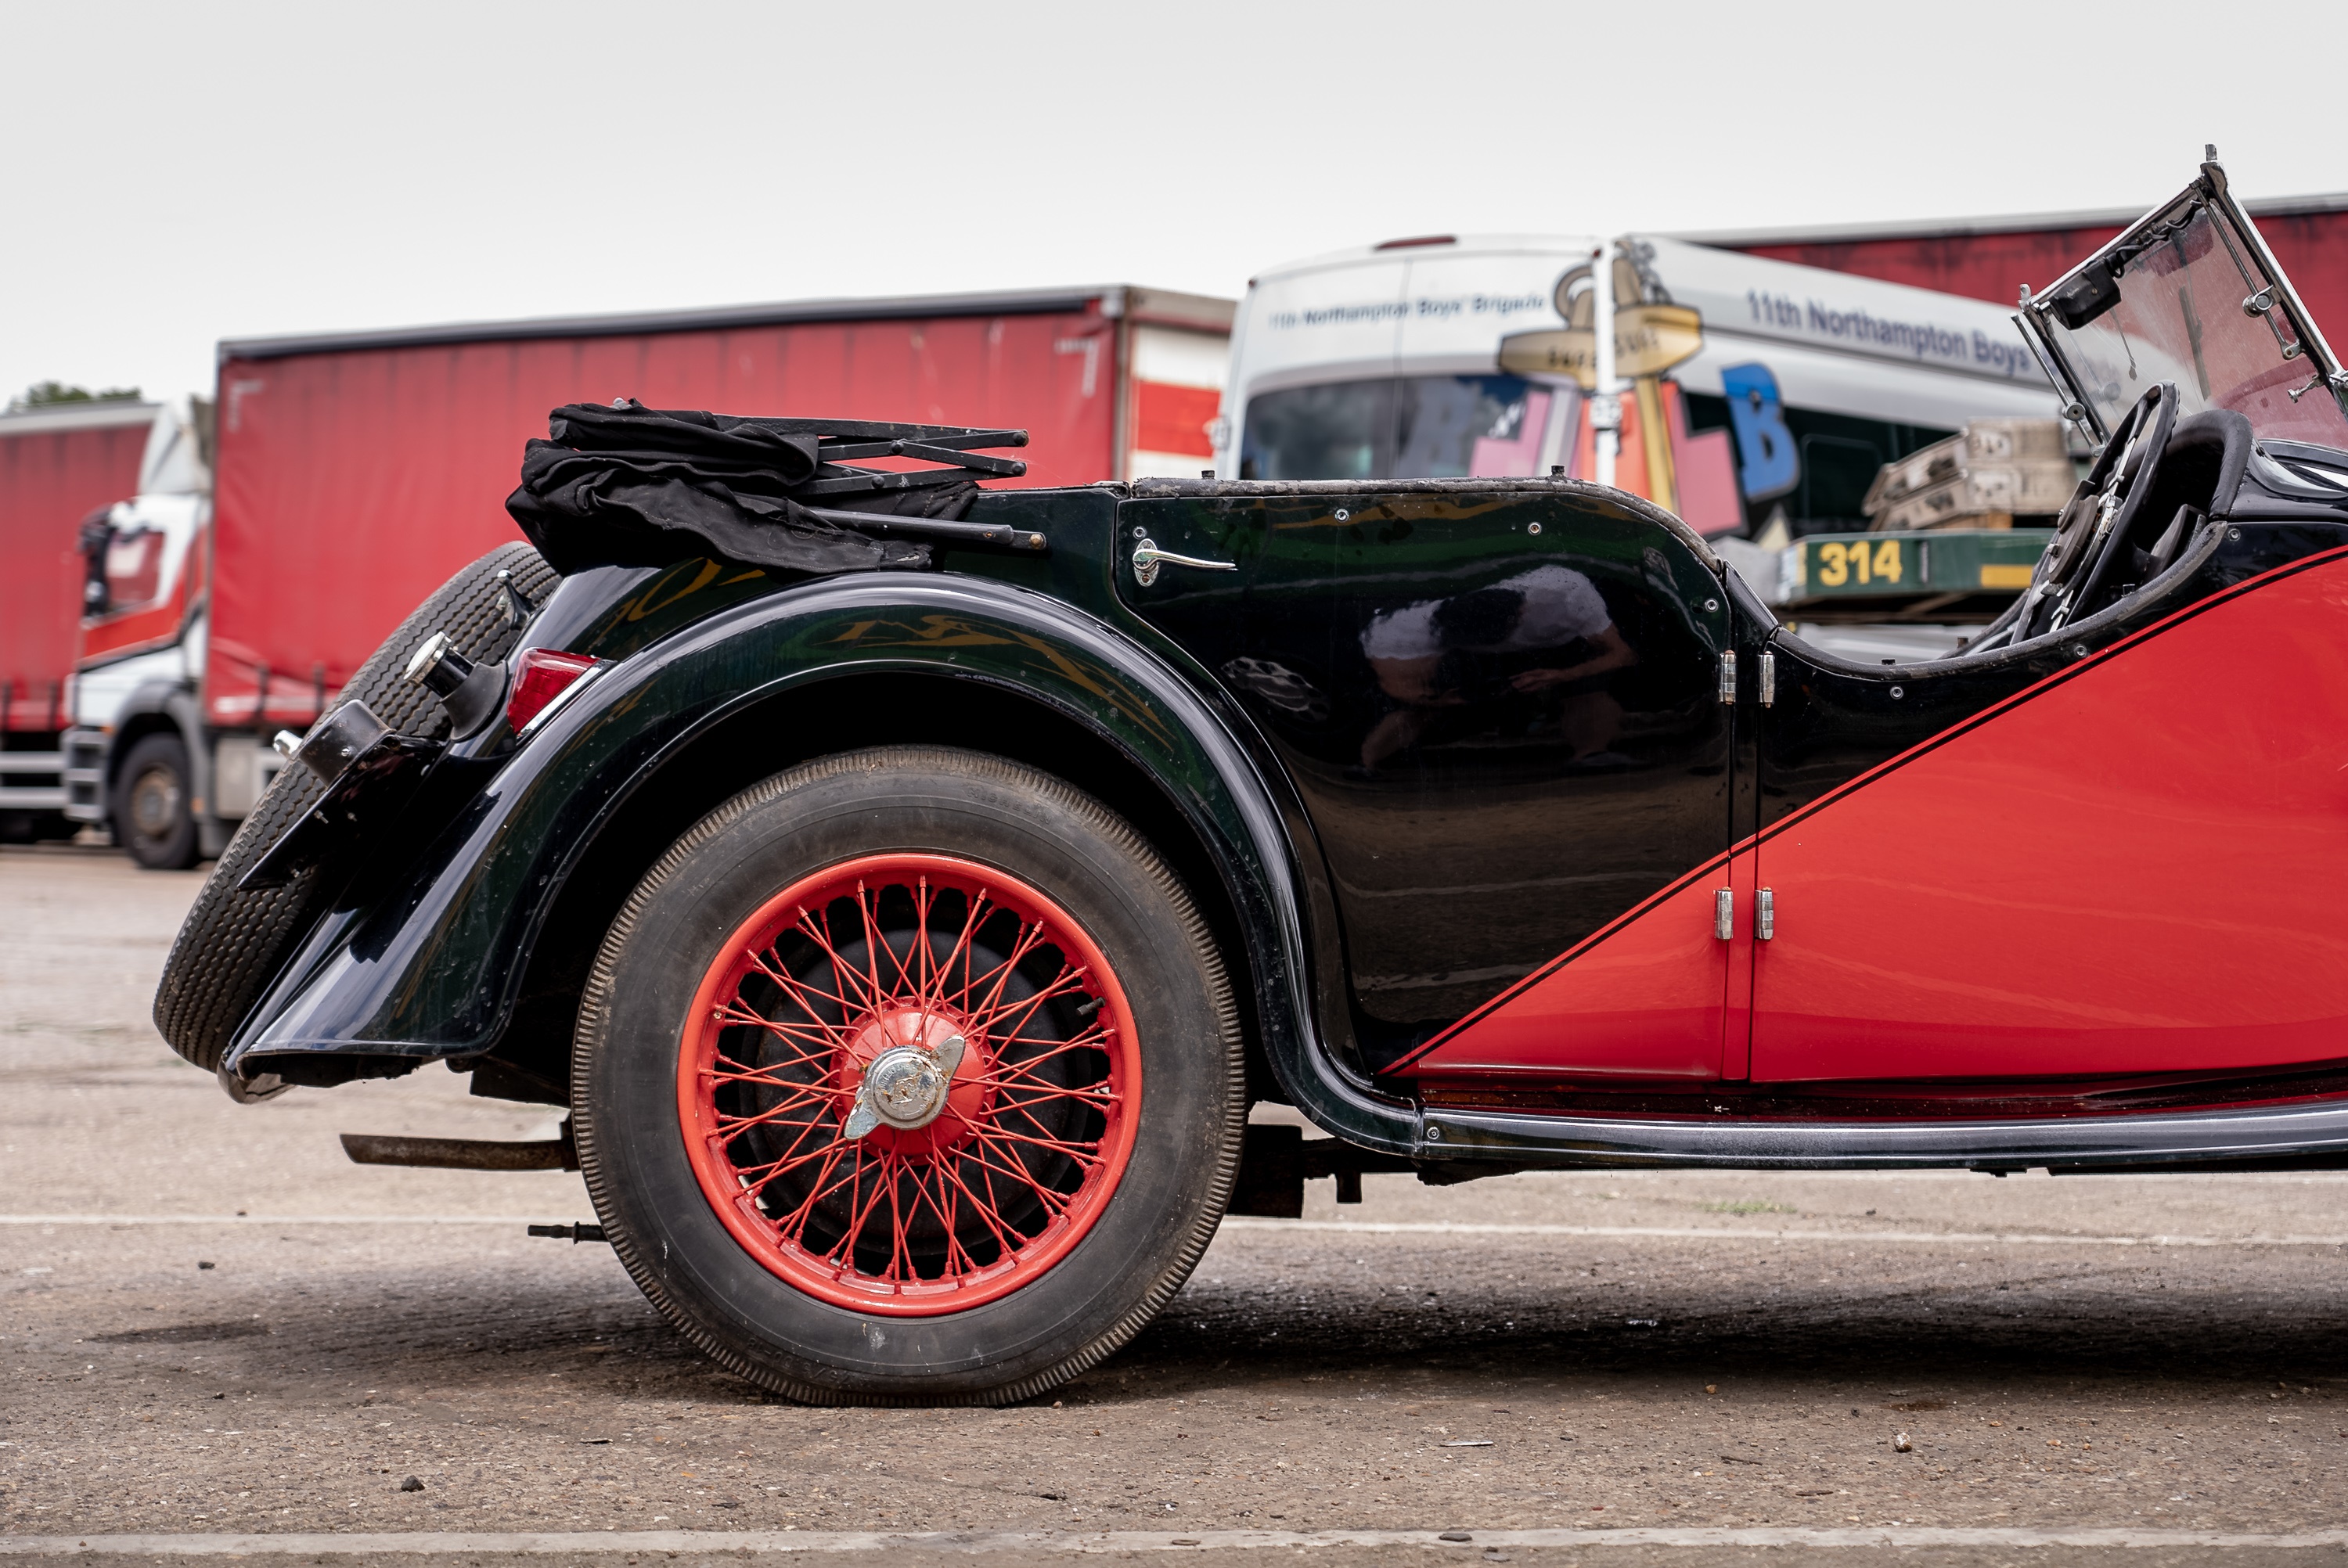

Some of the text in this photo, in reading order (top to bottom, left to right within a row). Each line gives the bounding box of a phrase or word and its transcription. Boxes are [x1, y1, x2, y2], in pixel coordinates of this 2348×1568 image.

[1747, 289, 1800, 328] 11th
[1806, 297, 1967, 361] Northampton
[1972, 329, 2031, 377] Boys
[1818, 539, 1903, 586] 314
[967, 785, 1053, 825] MICHELIN
